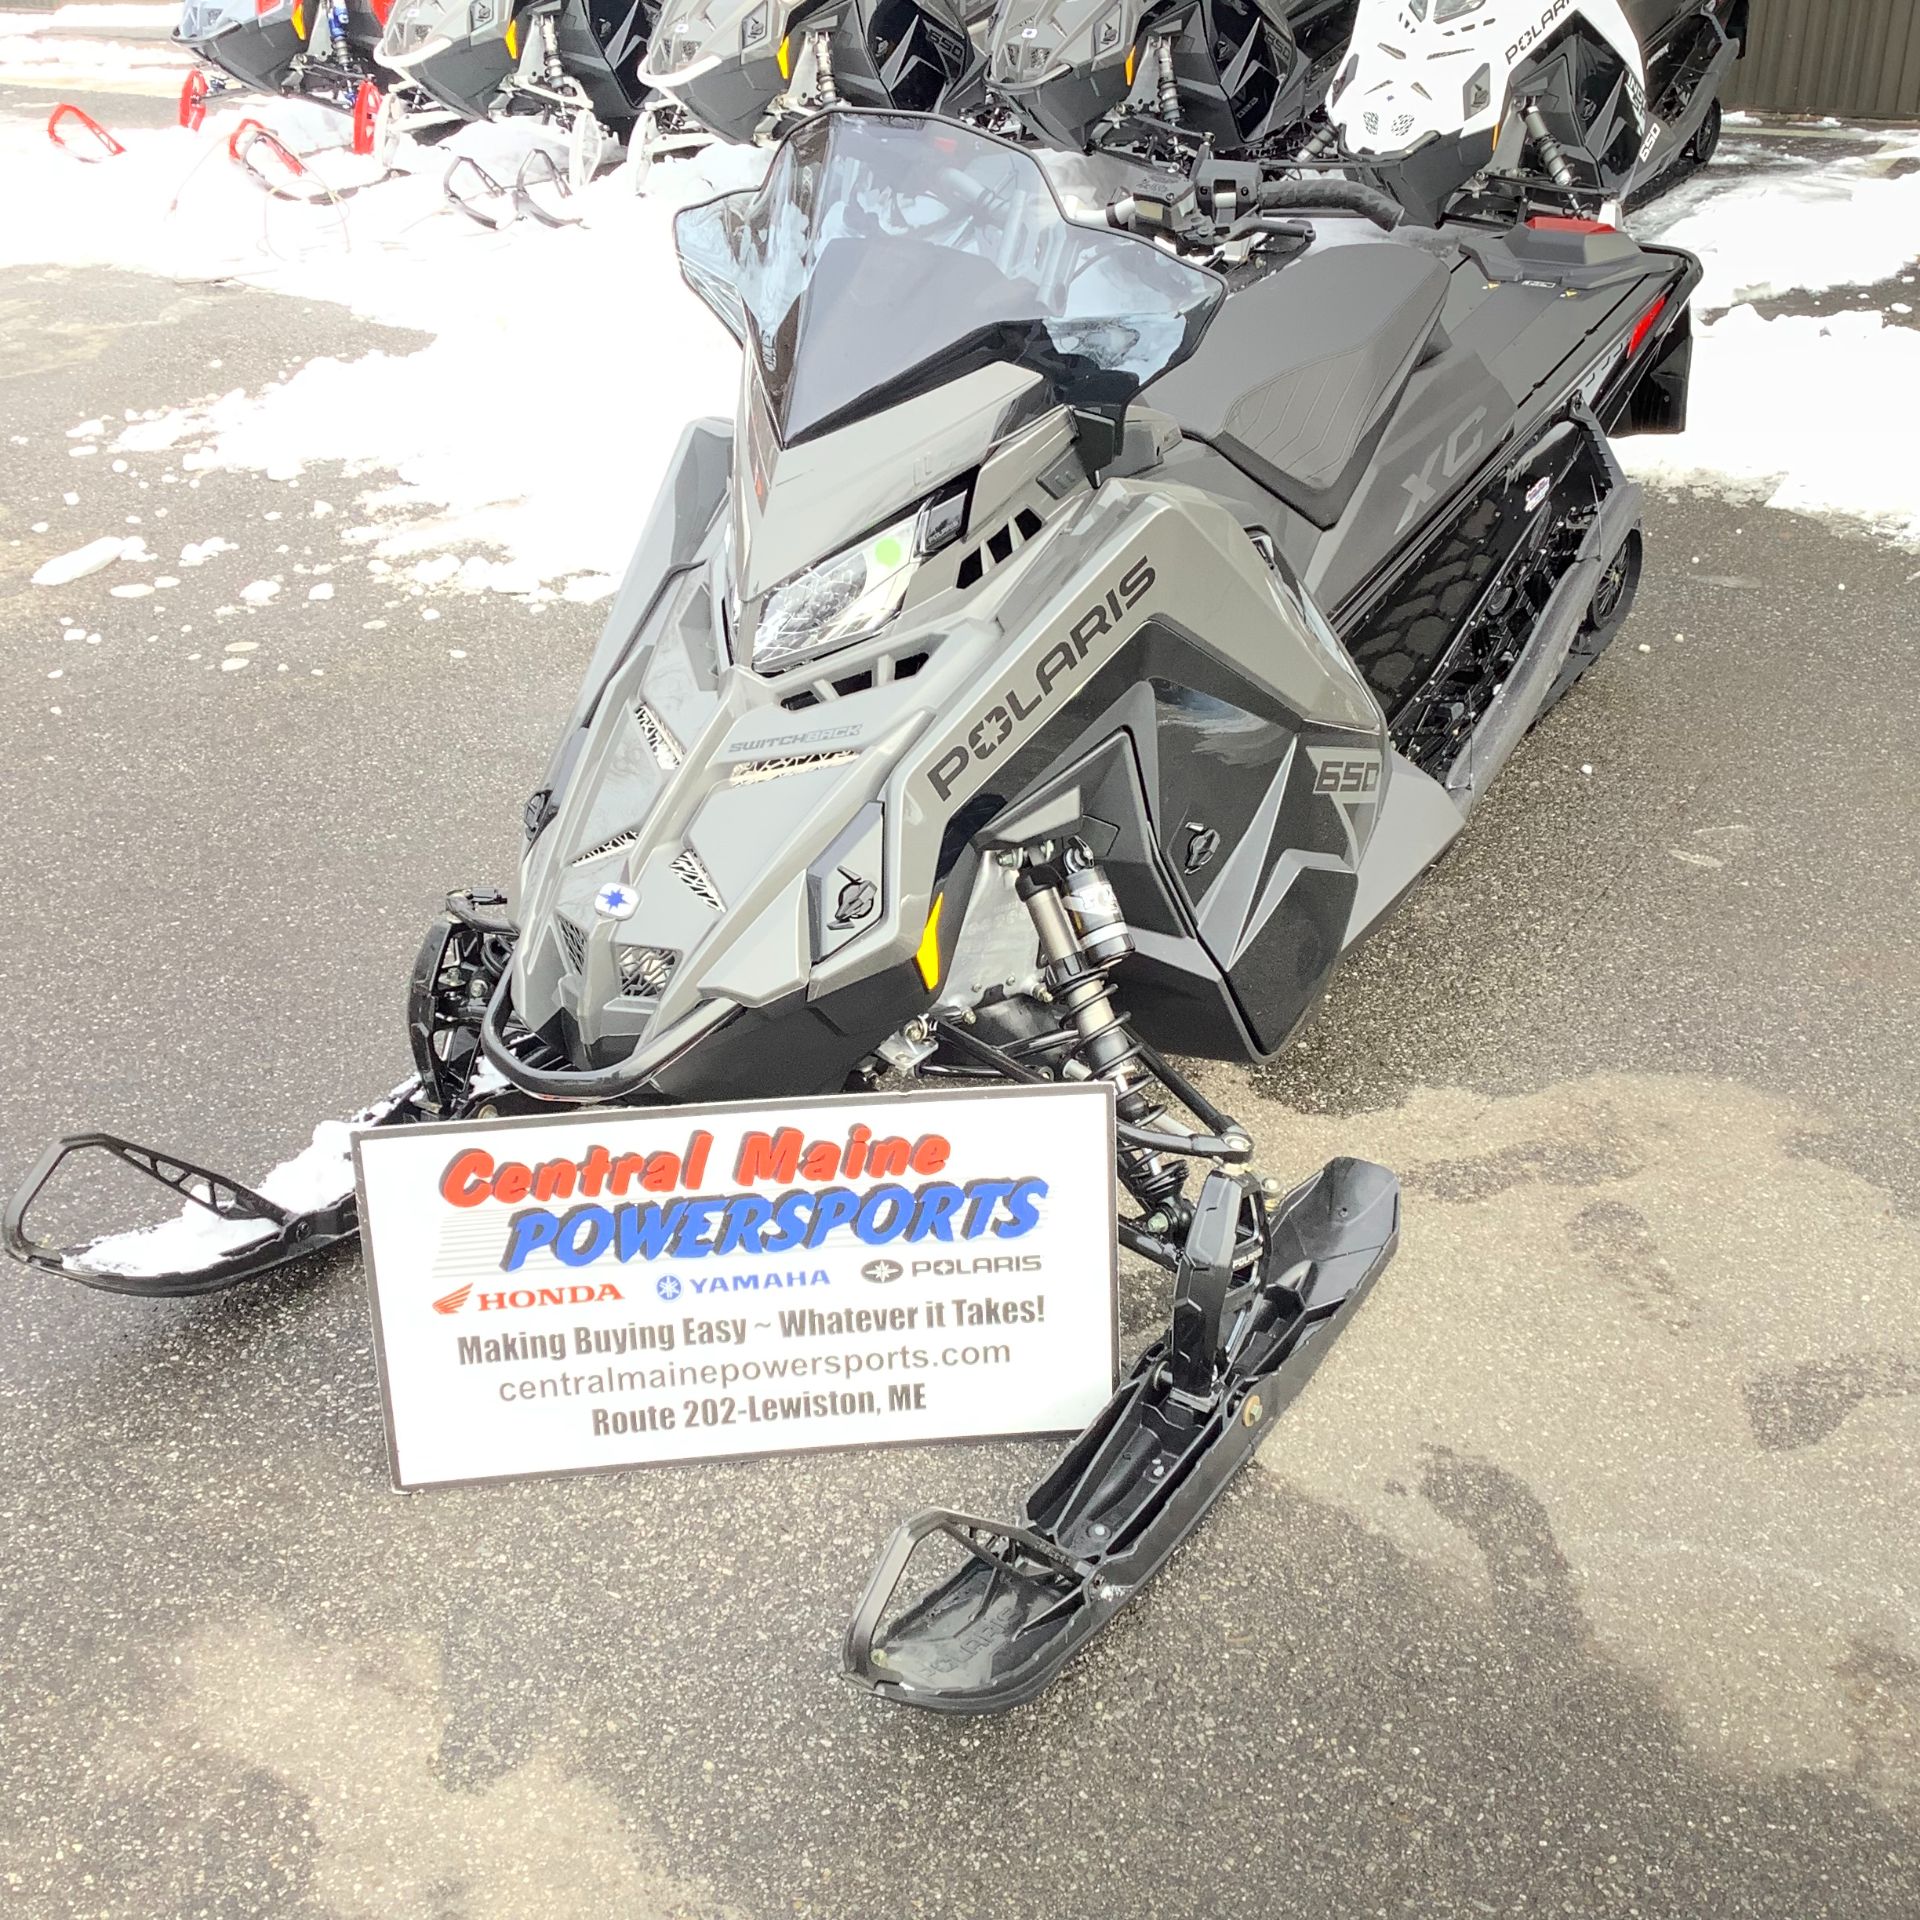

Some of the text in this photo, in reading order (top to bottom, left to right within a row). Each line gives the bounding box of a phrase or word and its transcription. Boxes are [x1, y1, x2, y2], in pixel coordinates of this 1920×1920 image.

[928, 29, 963, 59] 650
[1505, 0, 1570, 65] POLAR
[1639, 122, 1661, 162] 650
[1394, 406, 1487, 535] XC
[927, 555, 1156, 801] POLARIS
[728, 723, 863, 753] SWITCHBACK
[1314, 761, 1380, 792] 650
[439, 1122, 951, 1208] Central Maine
[499, 1176, 1049, 1272] POWERSPORTS
[689, 1269, 831, 1295] YAMAHA
[911, 1255, 1043, 1277] POLARIS
[477, 1283, 626, 1312] HONDA
[457, 1331, 567, 1366] Making
[573, 1322, 675, 1356] Buying
[682, 1317, 747, 1346] Easy
[778, 1305, 918, 1339] Whatever
[925, 1300, 946, 1329] it
[952, 1295, 1045, 1327] Takes!
[499, 1344, 1011, 1402] centralmainepowersports.com
[591, 1382, 927, 1437] Route 202-Lewiston, ME
